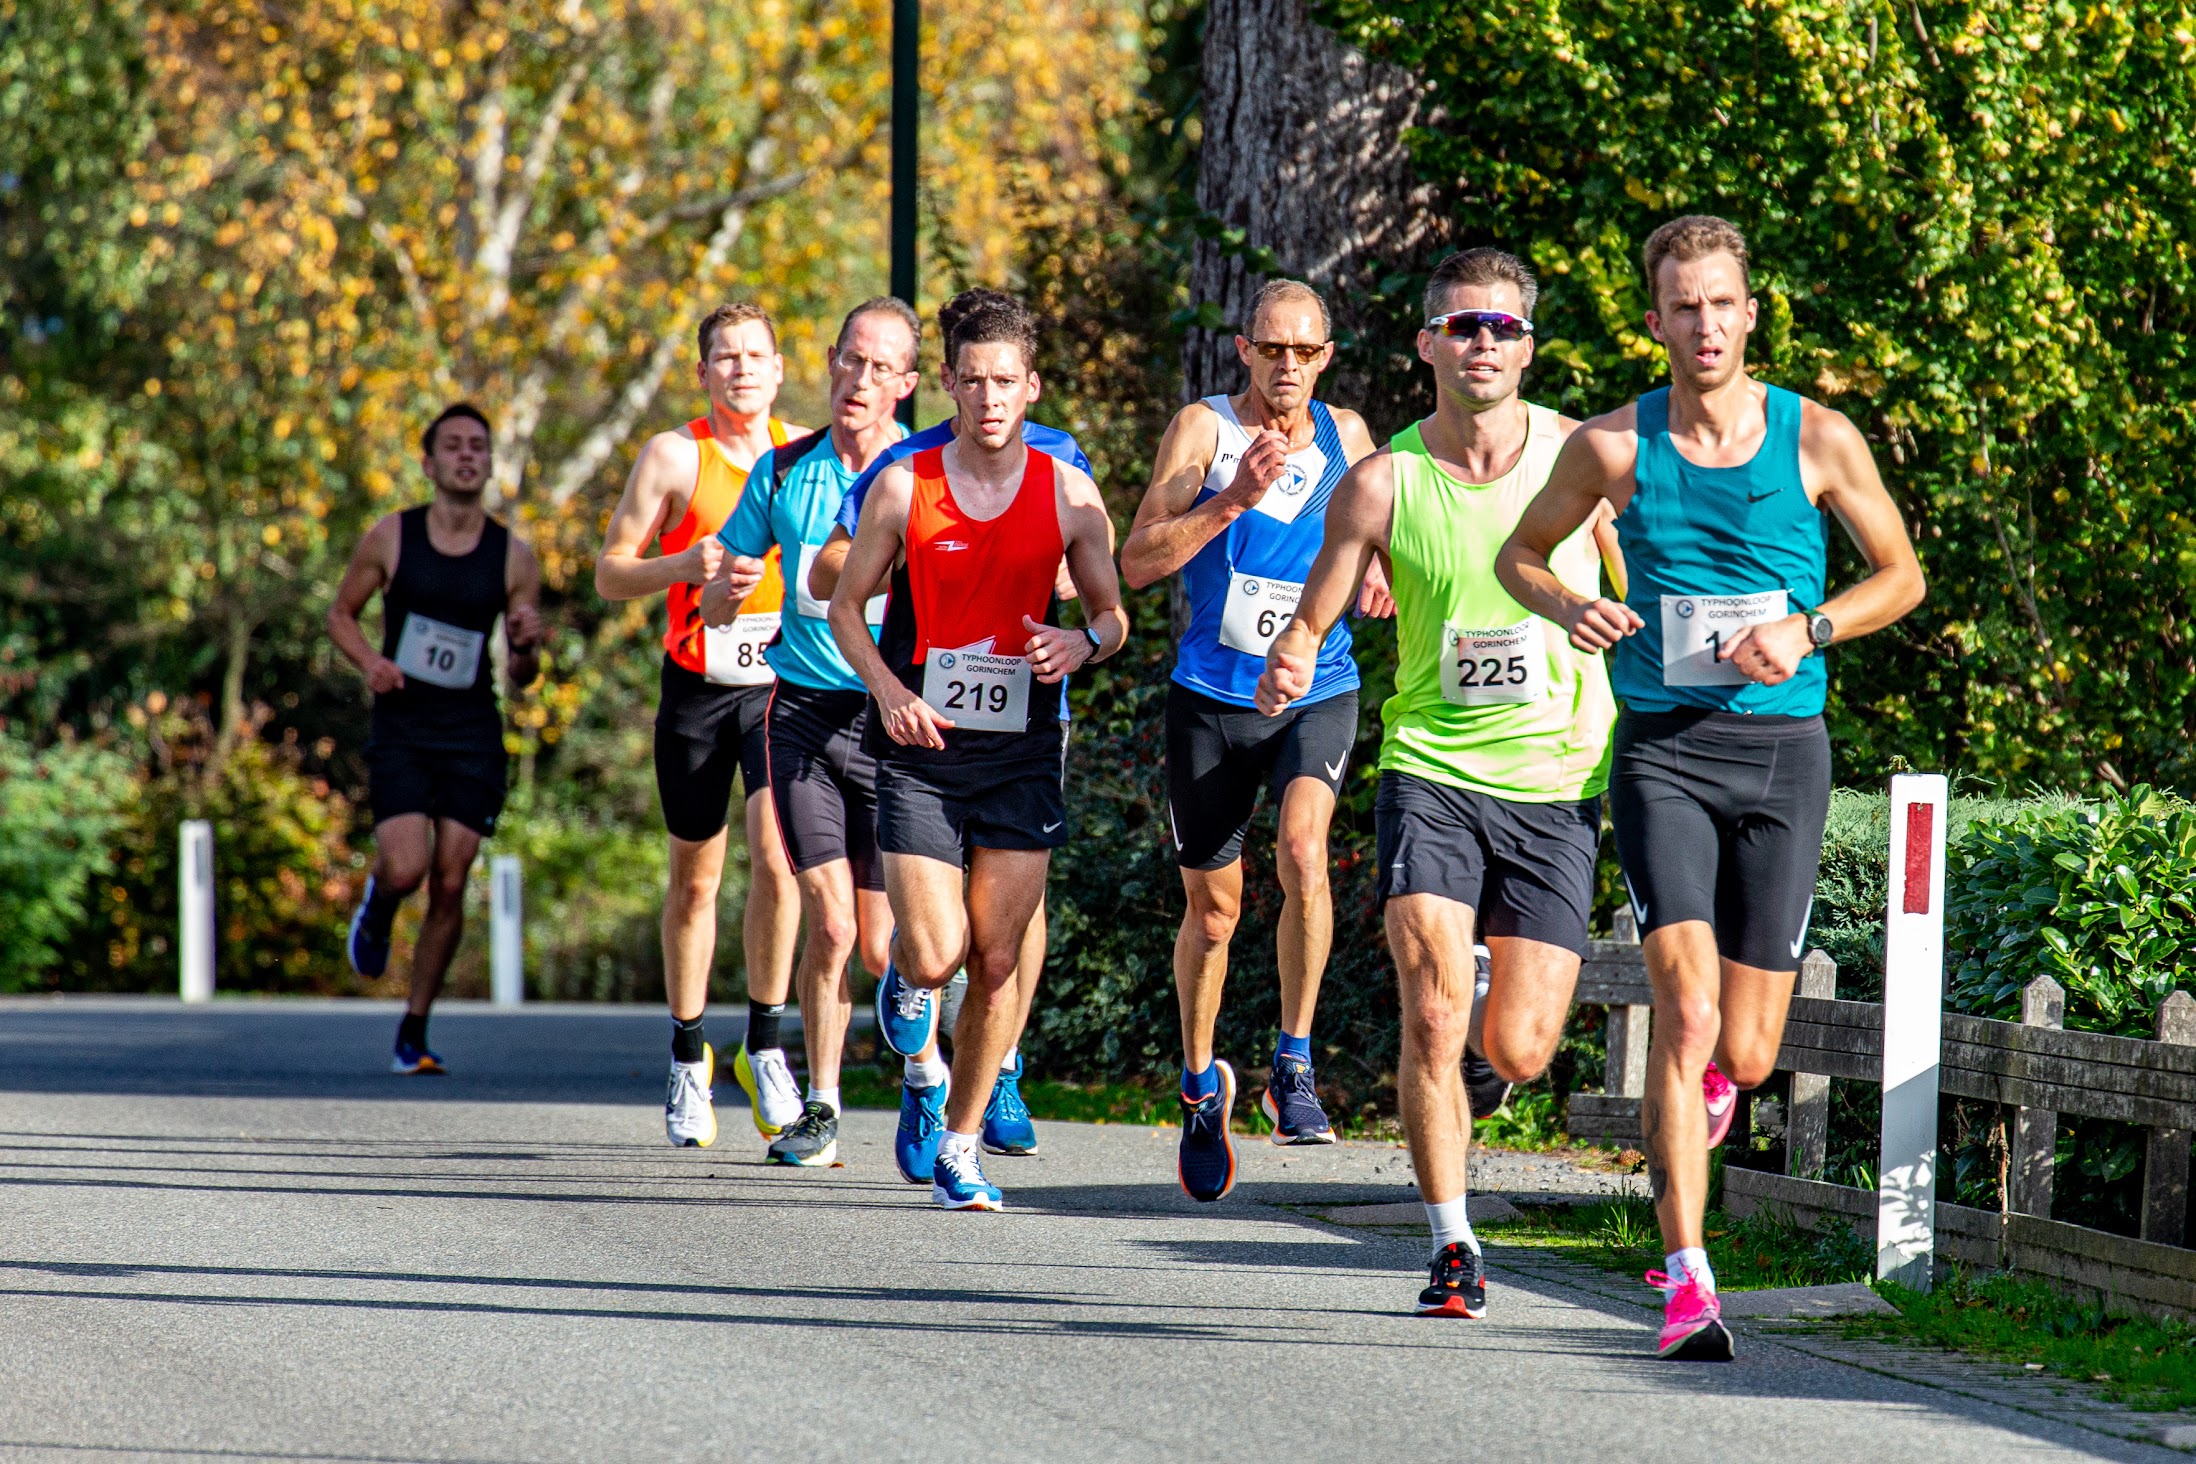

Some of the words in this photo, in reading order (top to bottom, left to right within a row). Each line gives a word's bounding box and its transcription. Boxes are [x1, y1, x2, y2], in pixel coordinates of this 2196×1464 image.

[1701, 595, 1772, 607] TYPHOONLOOP
[1708, 608, 1767, 619] GORINCHEM
[1465, 621, 1529, 638] TYPHOONLOOP
[1472, 635, 1528, 648] GORINCHEM
[1705, 630, 1721, 664] 1
[426, 644, 455, 672] 10
[962, 653, 1021, 666] TYPHOONLOOP
[966, 664, 1016, 676] GORINCHEM
[1456, 655, 1528, 687] 225
[944, 680, 1008, 713] 219
